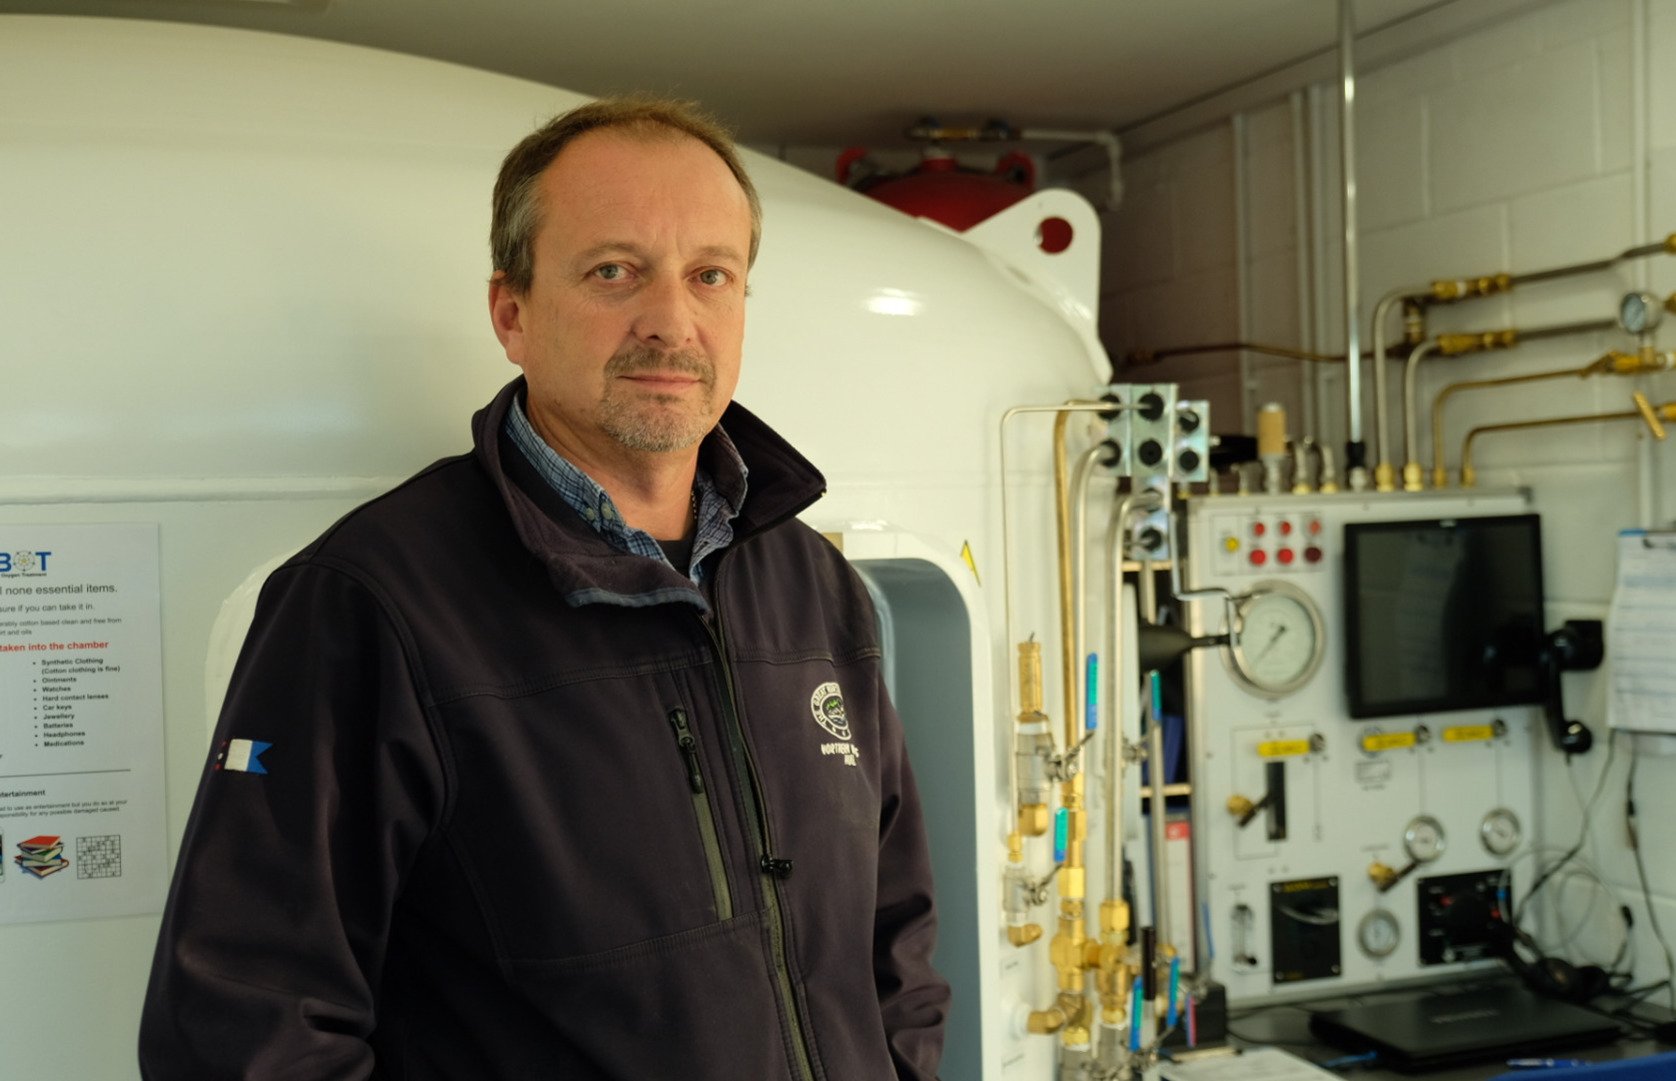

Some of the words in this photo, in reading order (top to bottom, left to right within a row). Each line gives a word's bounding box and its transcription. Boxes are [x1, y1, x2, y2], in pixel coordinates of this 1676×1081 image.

[5, 587, 32, 595] none
[35, 584, 83, 595] essential
[86, 583, 117, 593] items.
[18, 604, 24, 612] if
[25, 606, 40, 614] you
[59, 603, 76, 611] take
[0, 642, 25, 652] taken
[28, 642, 46, 652] into
[49, 641, 64, 650] the
[67, 640, 110, 650] chamber
[42, 658, 73, 667] Synthetic
[74, 658, 104, 666] Clothing
[68, 666, 96, 674] clothing
[105, 665, 121, 673] fine)
[43, 712, 75, 720] Jewellery
[44, 722, 74, 730] Batteries
[44, 730, 86, 738] Headphones
[44, 740, 85, 748] Medications
